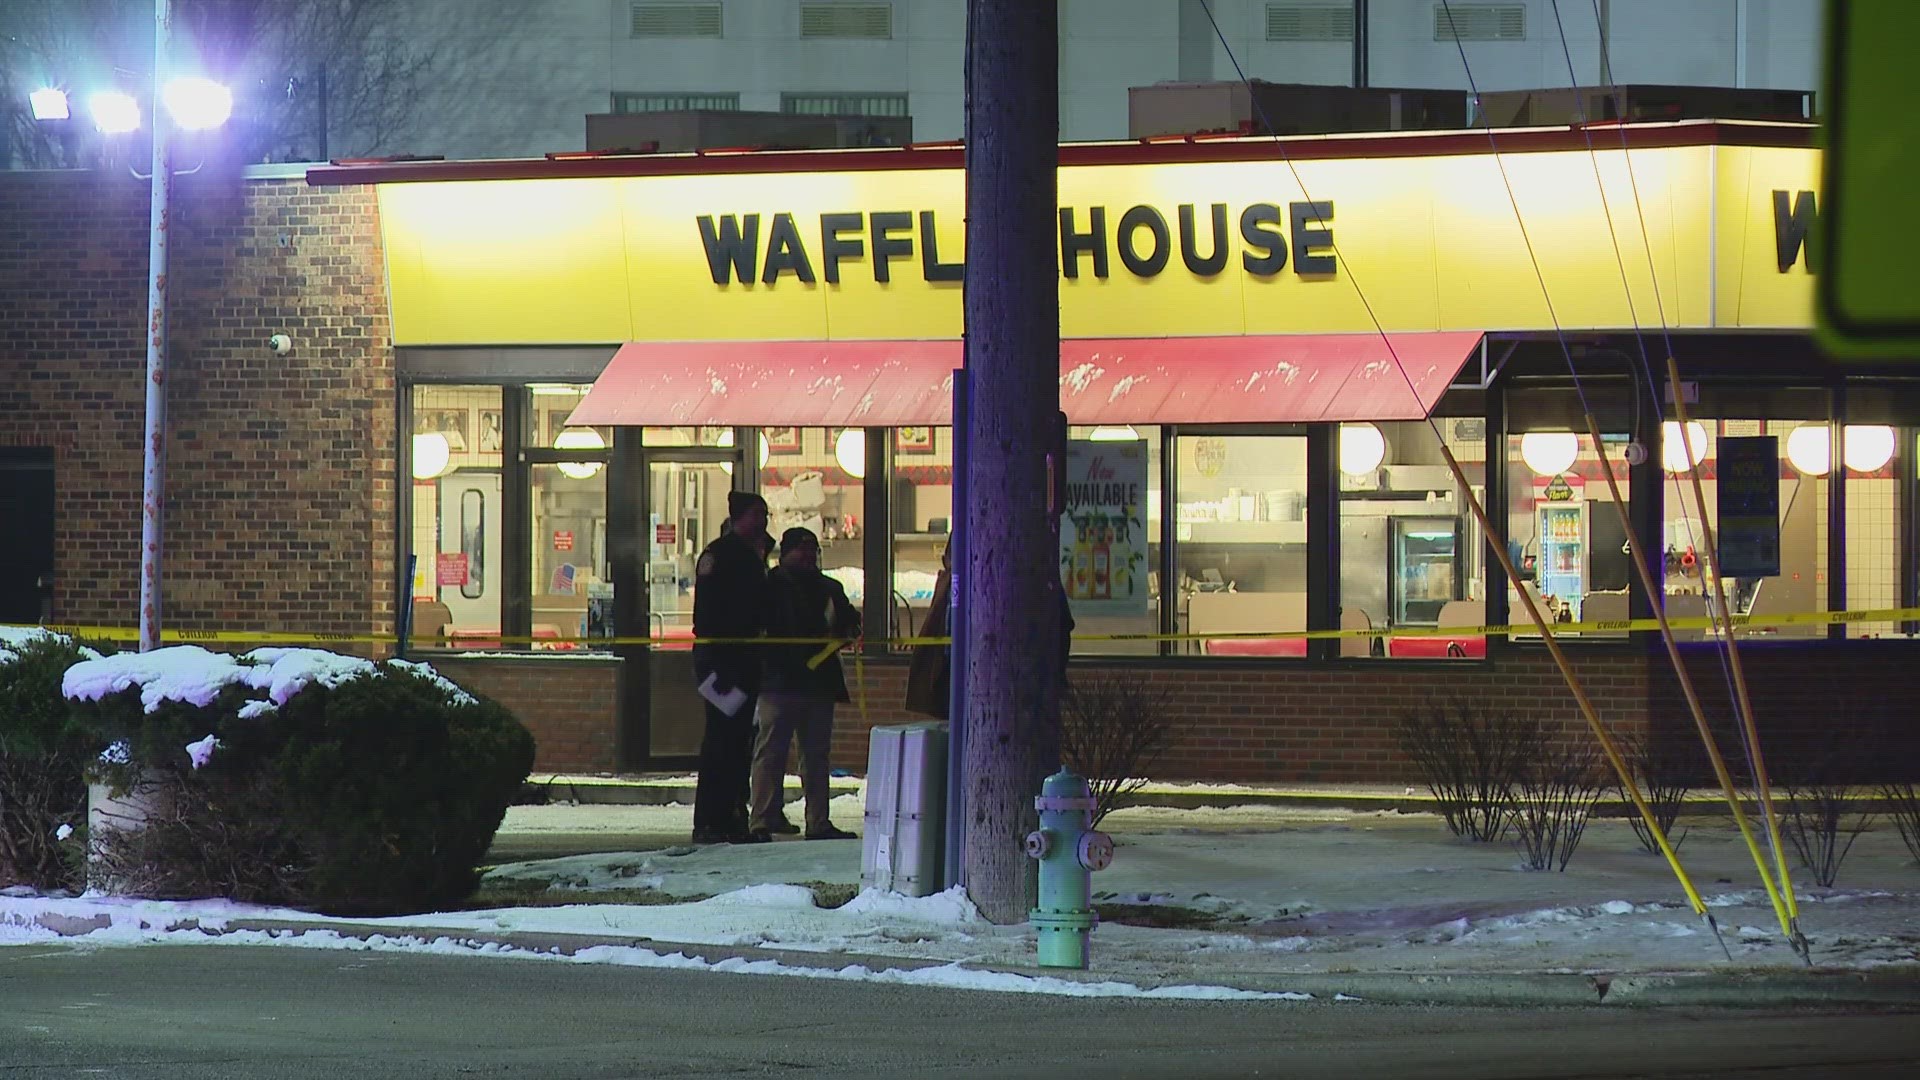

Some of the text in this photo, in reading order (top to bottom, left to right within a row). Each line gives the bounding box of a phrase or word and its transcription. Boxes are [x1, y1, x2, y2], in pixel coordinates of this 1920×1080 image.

[697, 200, 1337, 284] WAFFL HOUSE
[1087, 455, 1117, 481] New
[1067, 482, 1138, 509] AVAILABLE
